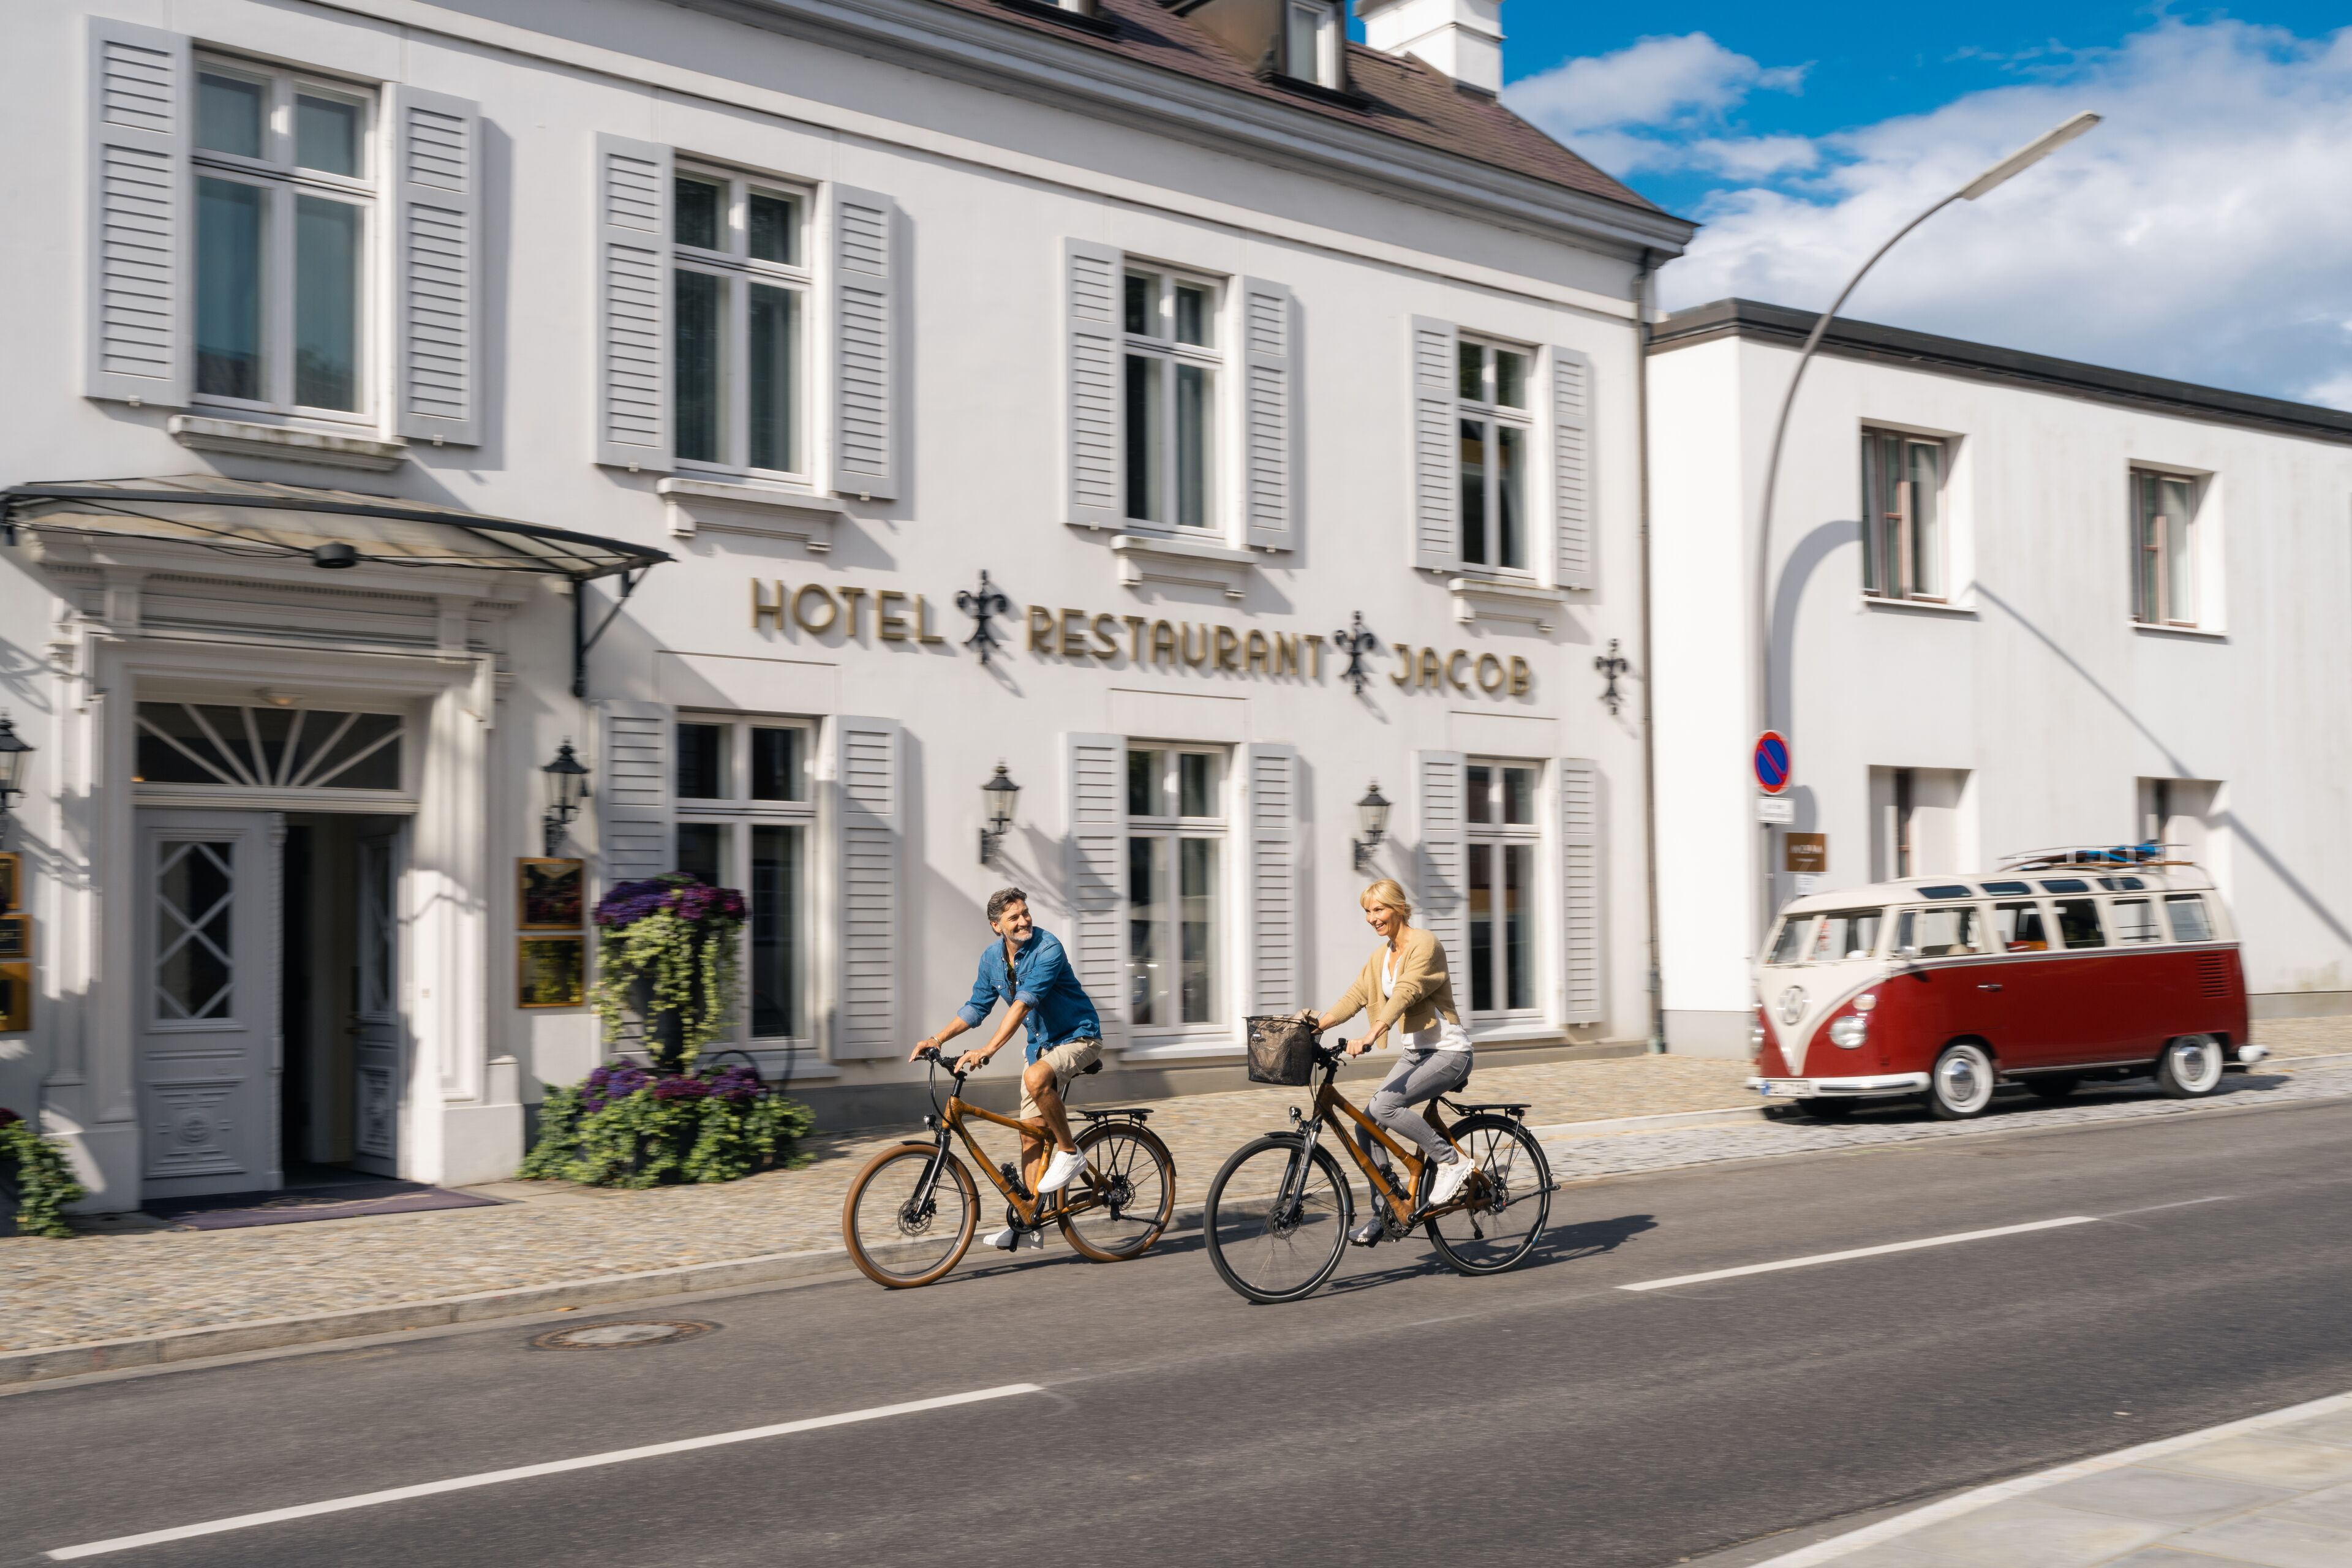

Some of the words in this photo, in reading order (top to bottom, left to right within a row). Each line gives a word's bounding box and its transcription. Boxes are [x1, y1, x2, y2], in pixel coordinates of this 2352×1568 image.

[750, 577, 944, 643] HOTEL
[1025, 605, 1324, 677] RESTAURANT
[1389, 643, 1529, 695] JACOB
